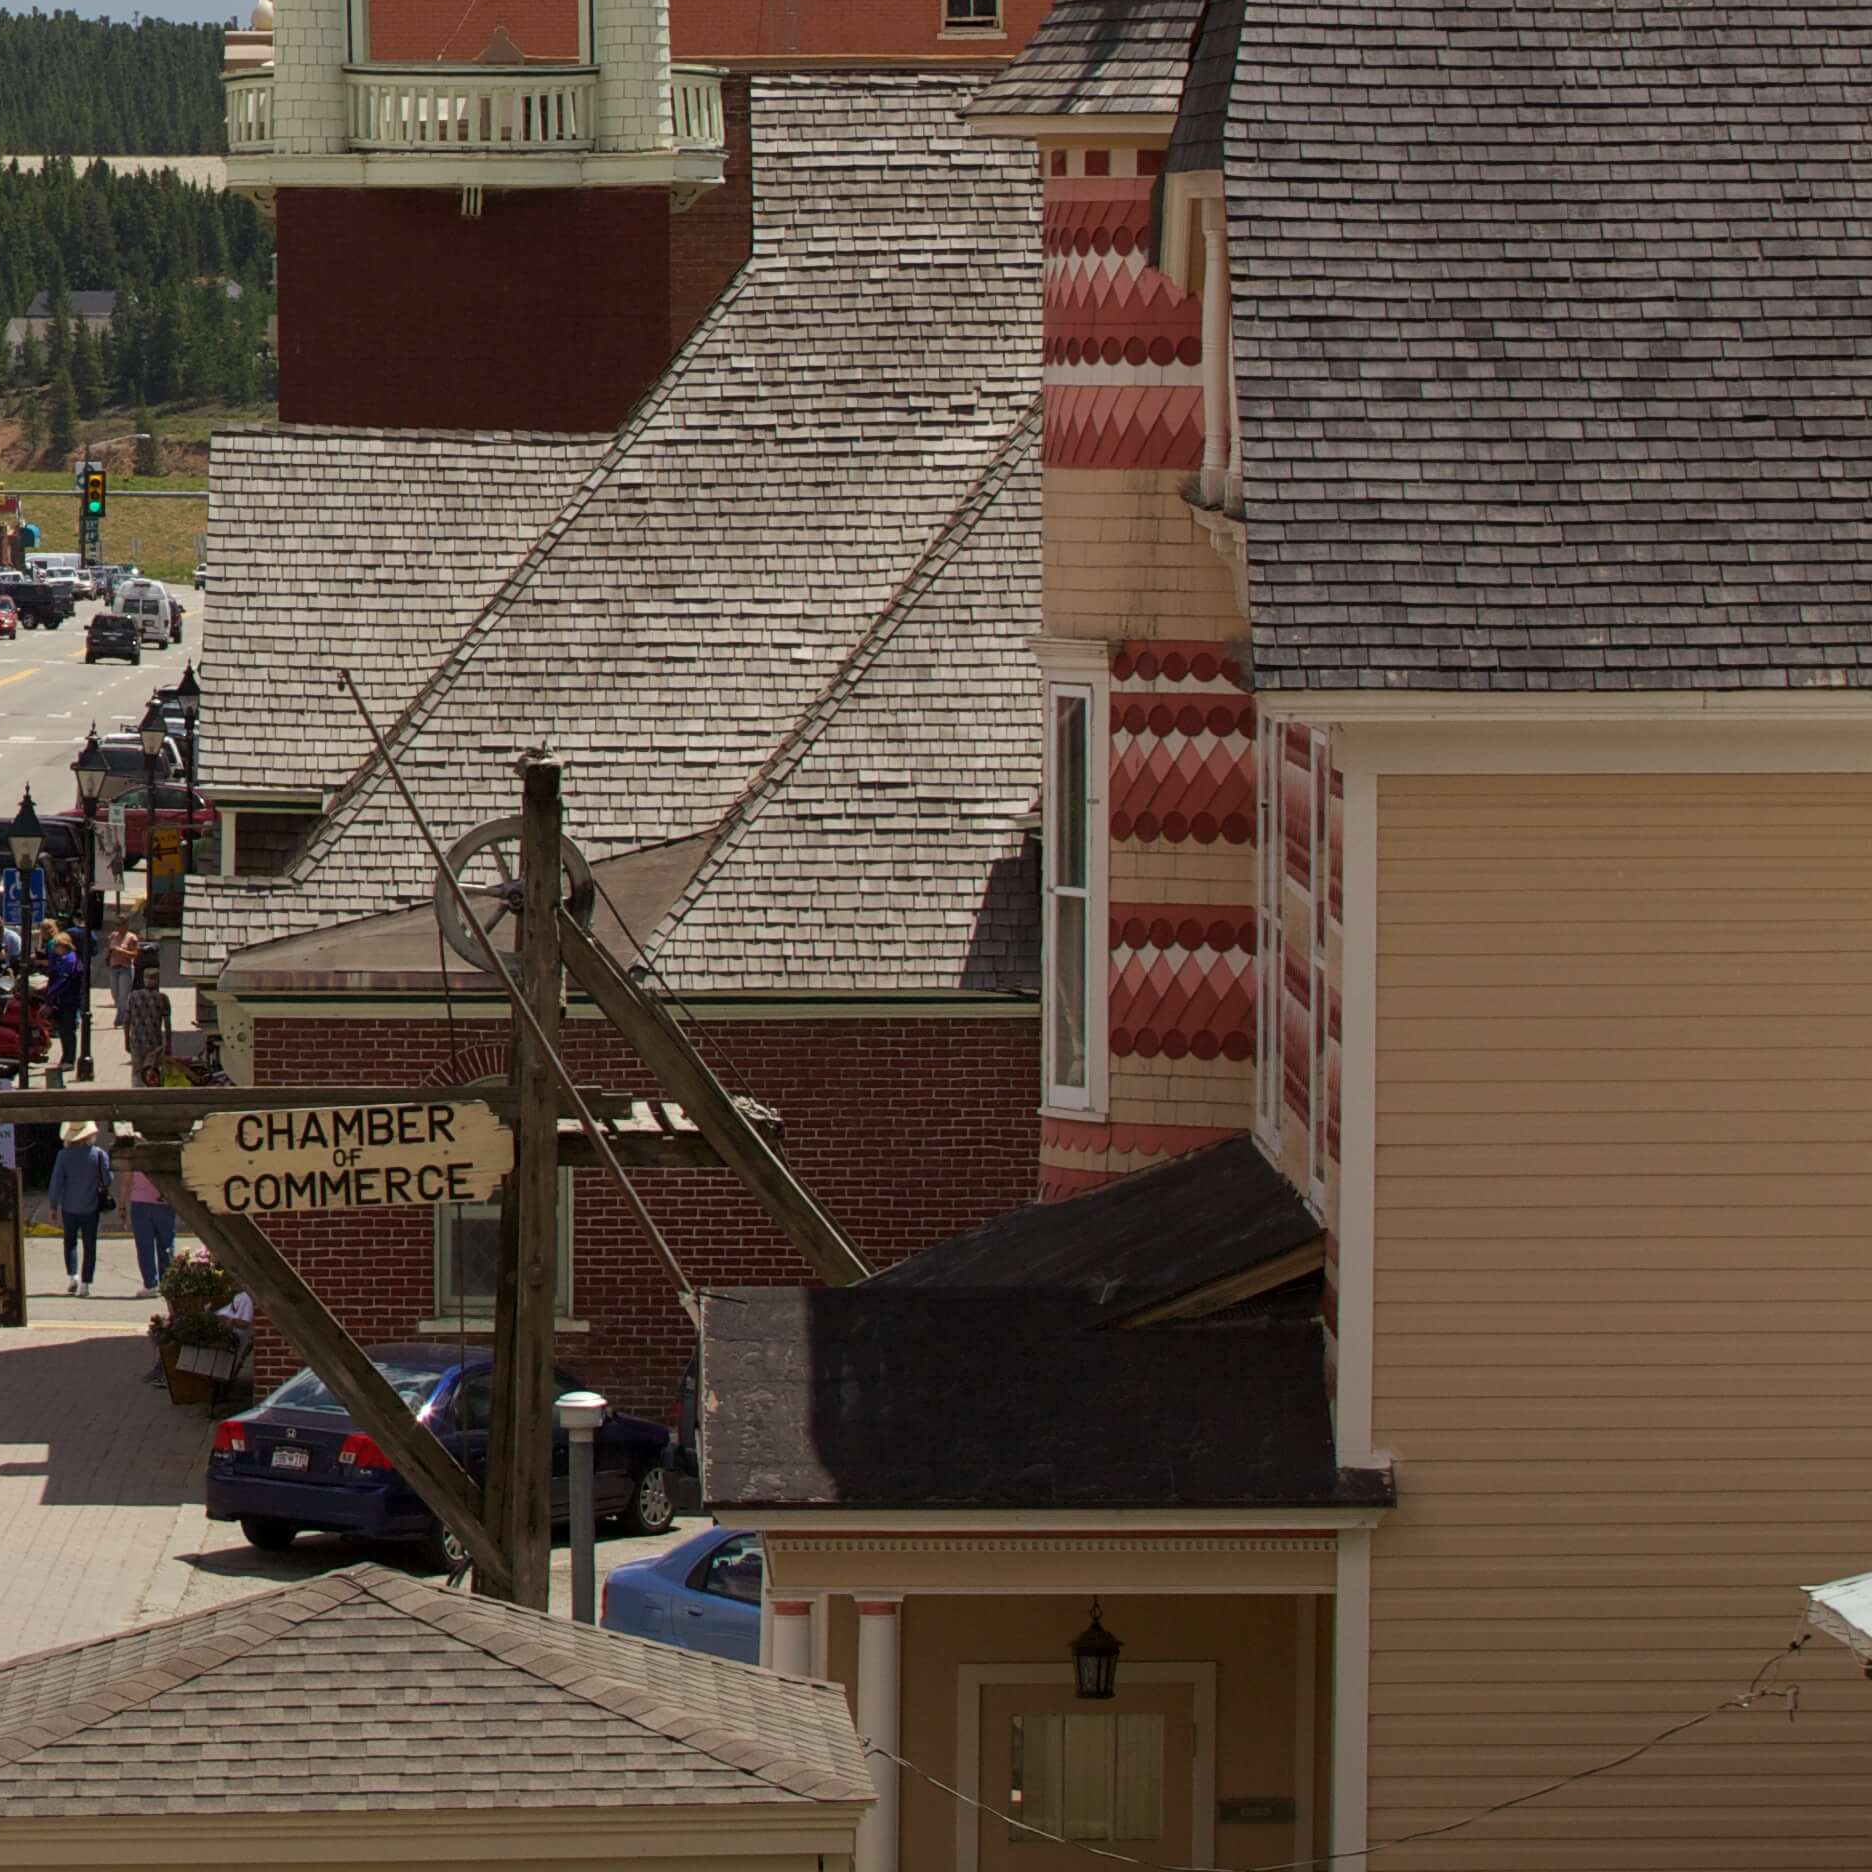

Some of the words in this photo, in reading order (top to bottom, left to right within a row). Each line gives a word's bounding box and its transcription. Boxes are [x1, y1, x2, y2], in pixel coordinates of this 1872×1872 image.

[235, 1104, 455, 1152] CHAMBER
[332, 1147, 362, 1168] OF
[223, 1162, 475, 1212] COMMERCE
